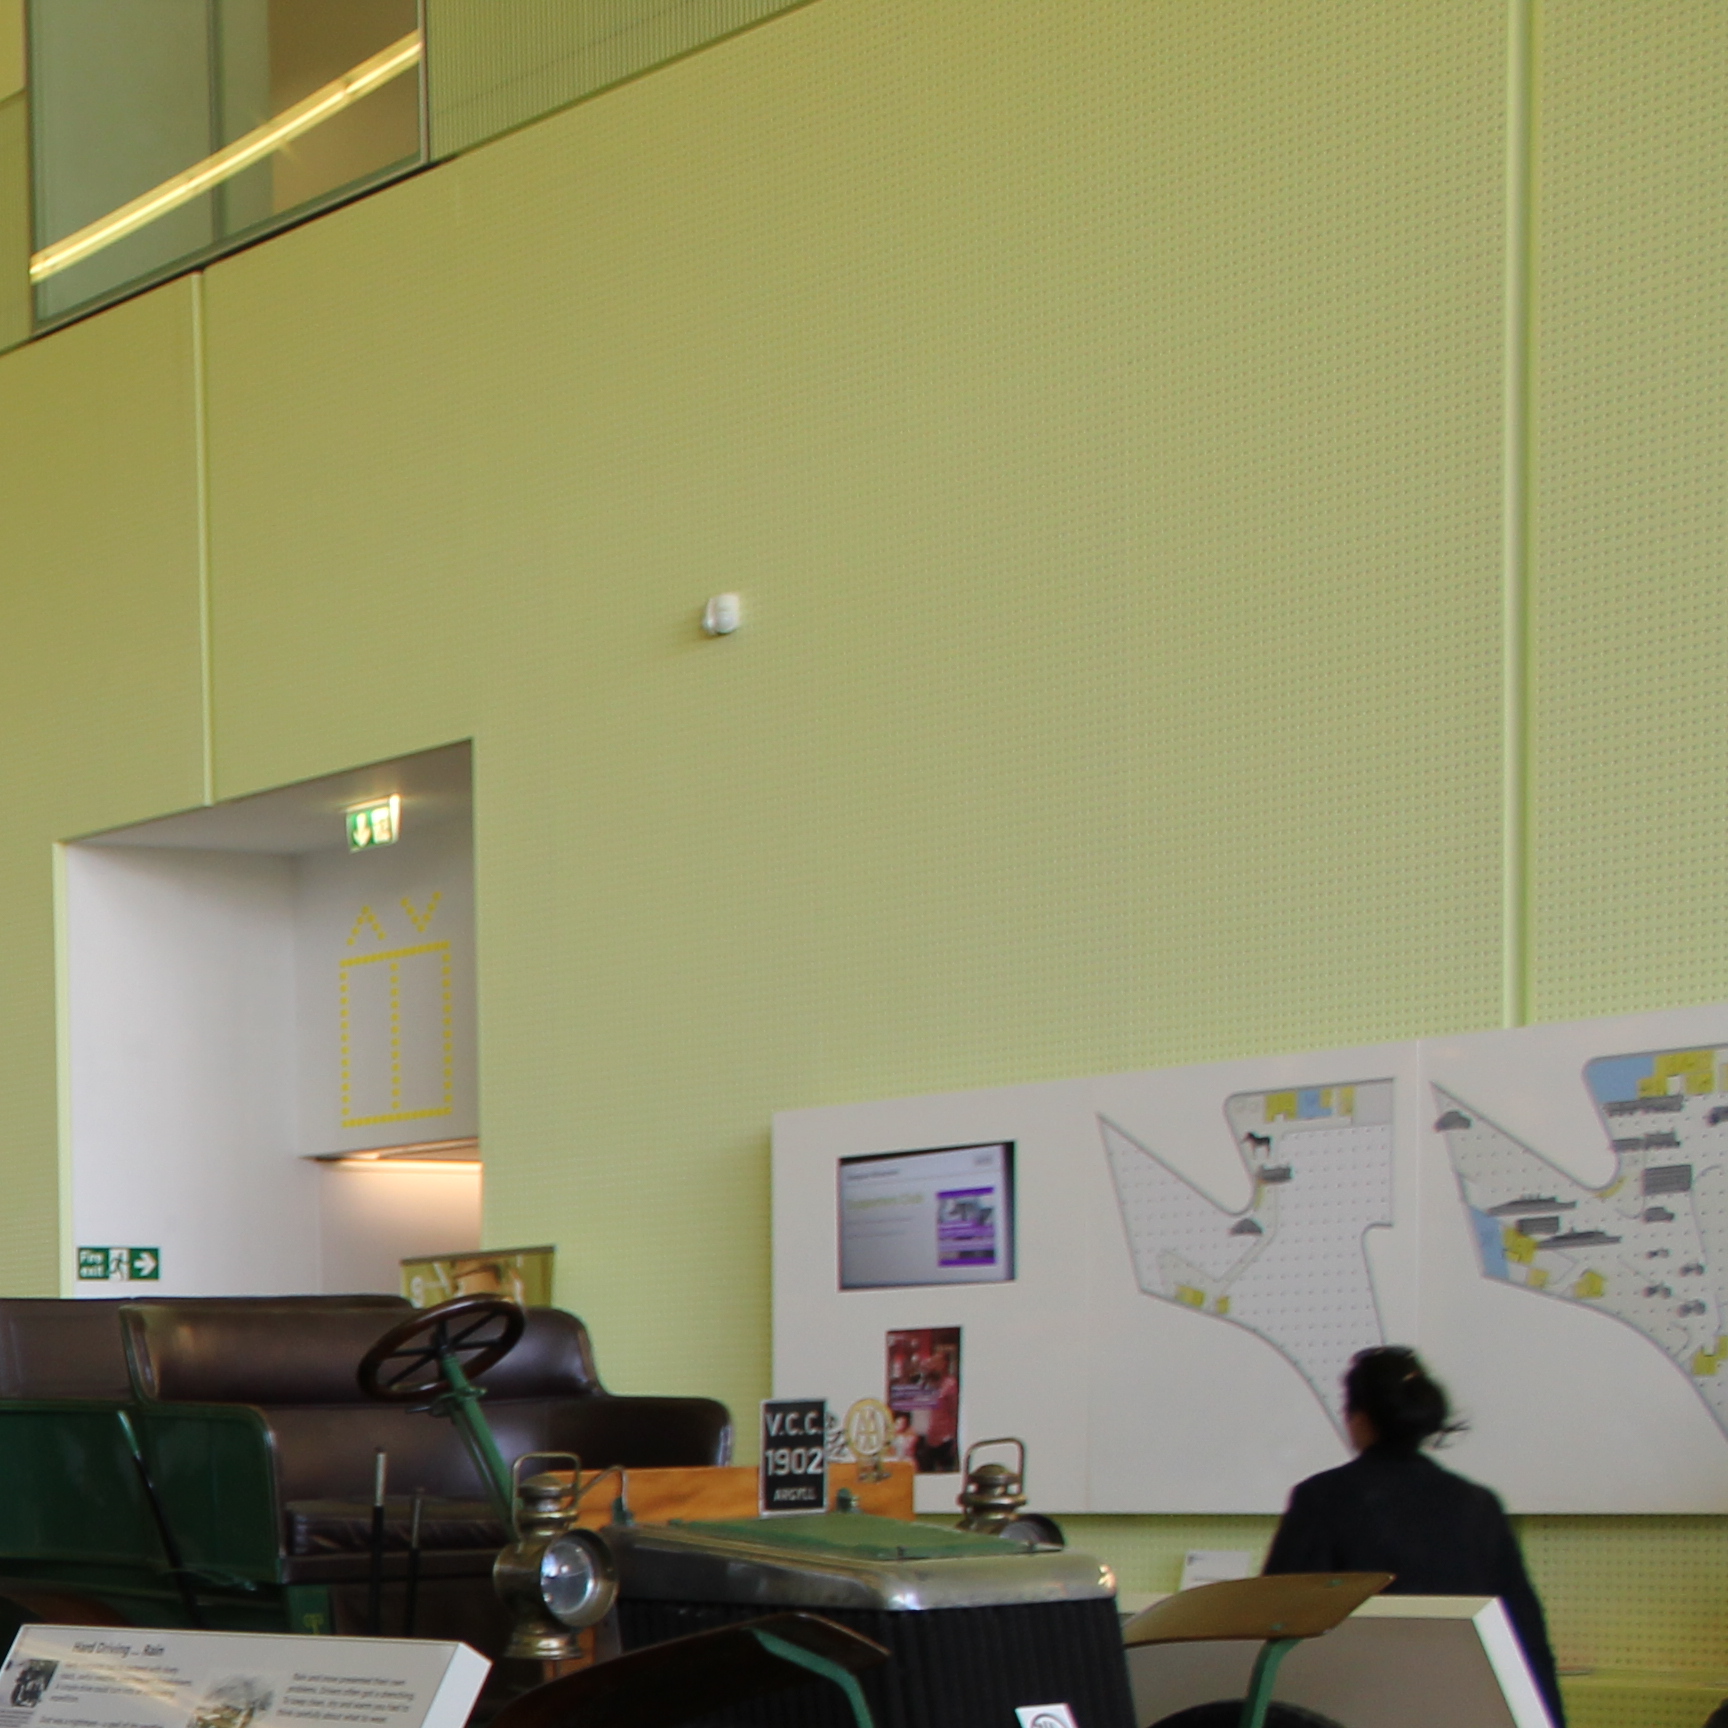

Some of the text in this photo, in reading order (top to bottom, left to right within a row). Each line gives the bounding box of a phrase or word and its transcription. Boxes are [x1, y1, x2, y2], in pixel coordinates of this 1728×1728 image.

[80, 1250, 103, 1263] Fire
[80, 1265, 103, 1277] exit
[765, 1411, 822, 1436] V.C.C.
[765, 1447, 823, 1475] 1902
[72, 1642, 97, 1653] Hard
[95, 1642, 131, 1658] Driving
[144, 1644, 164, 1656] Rain
